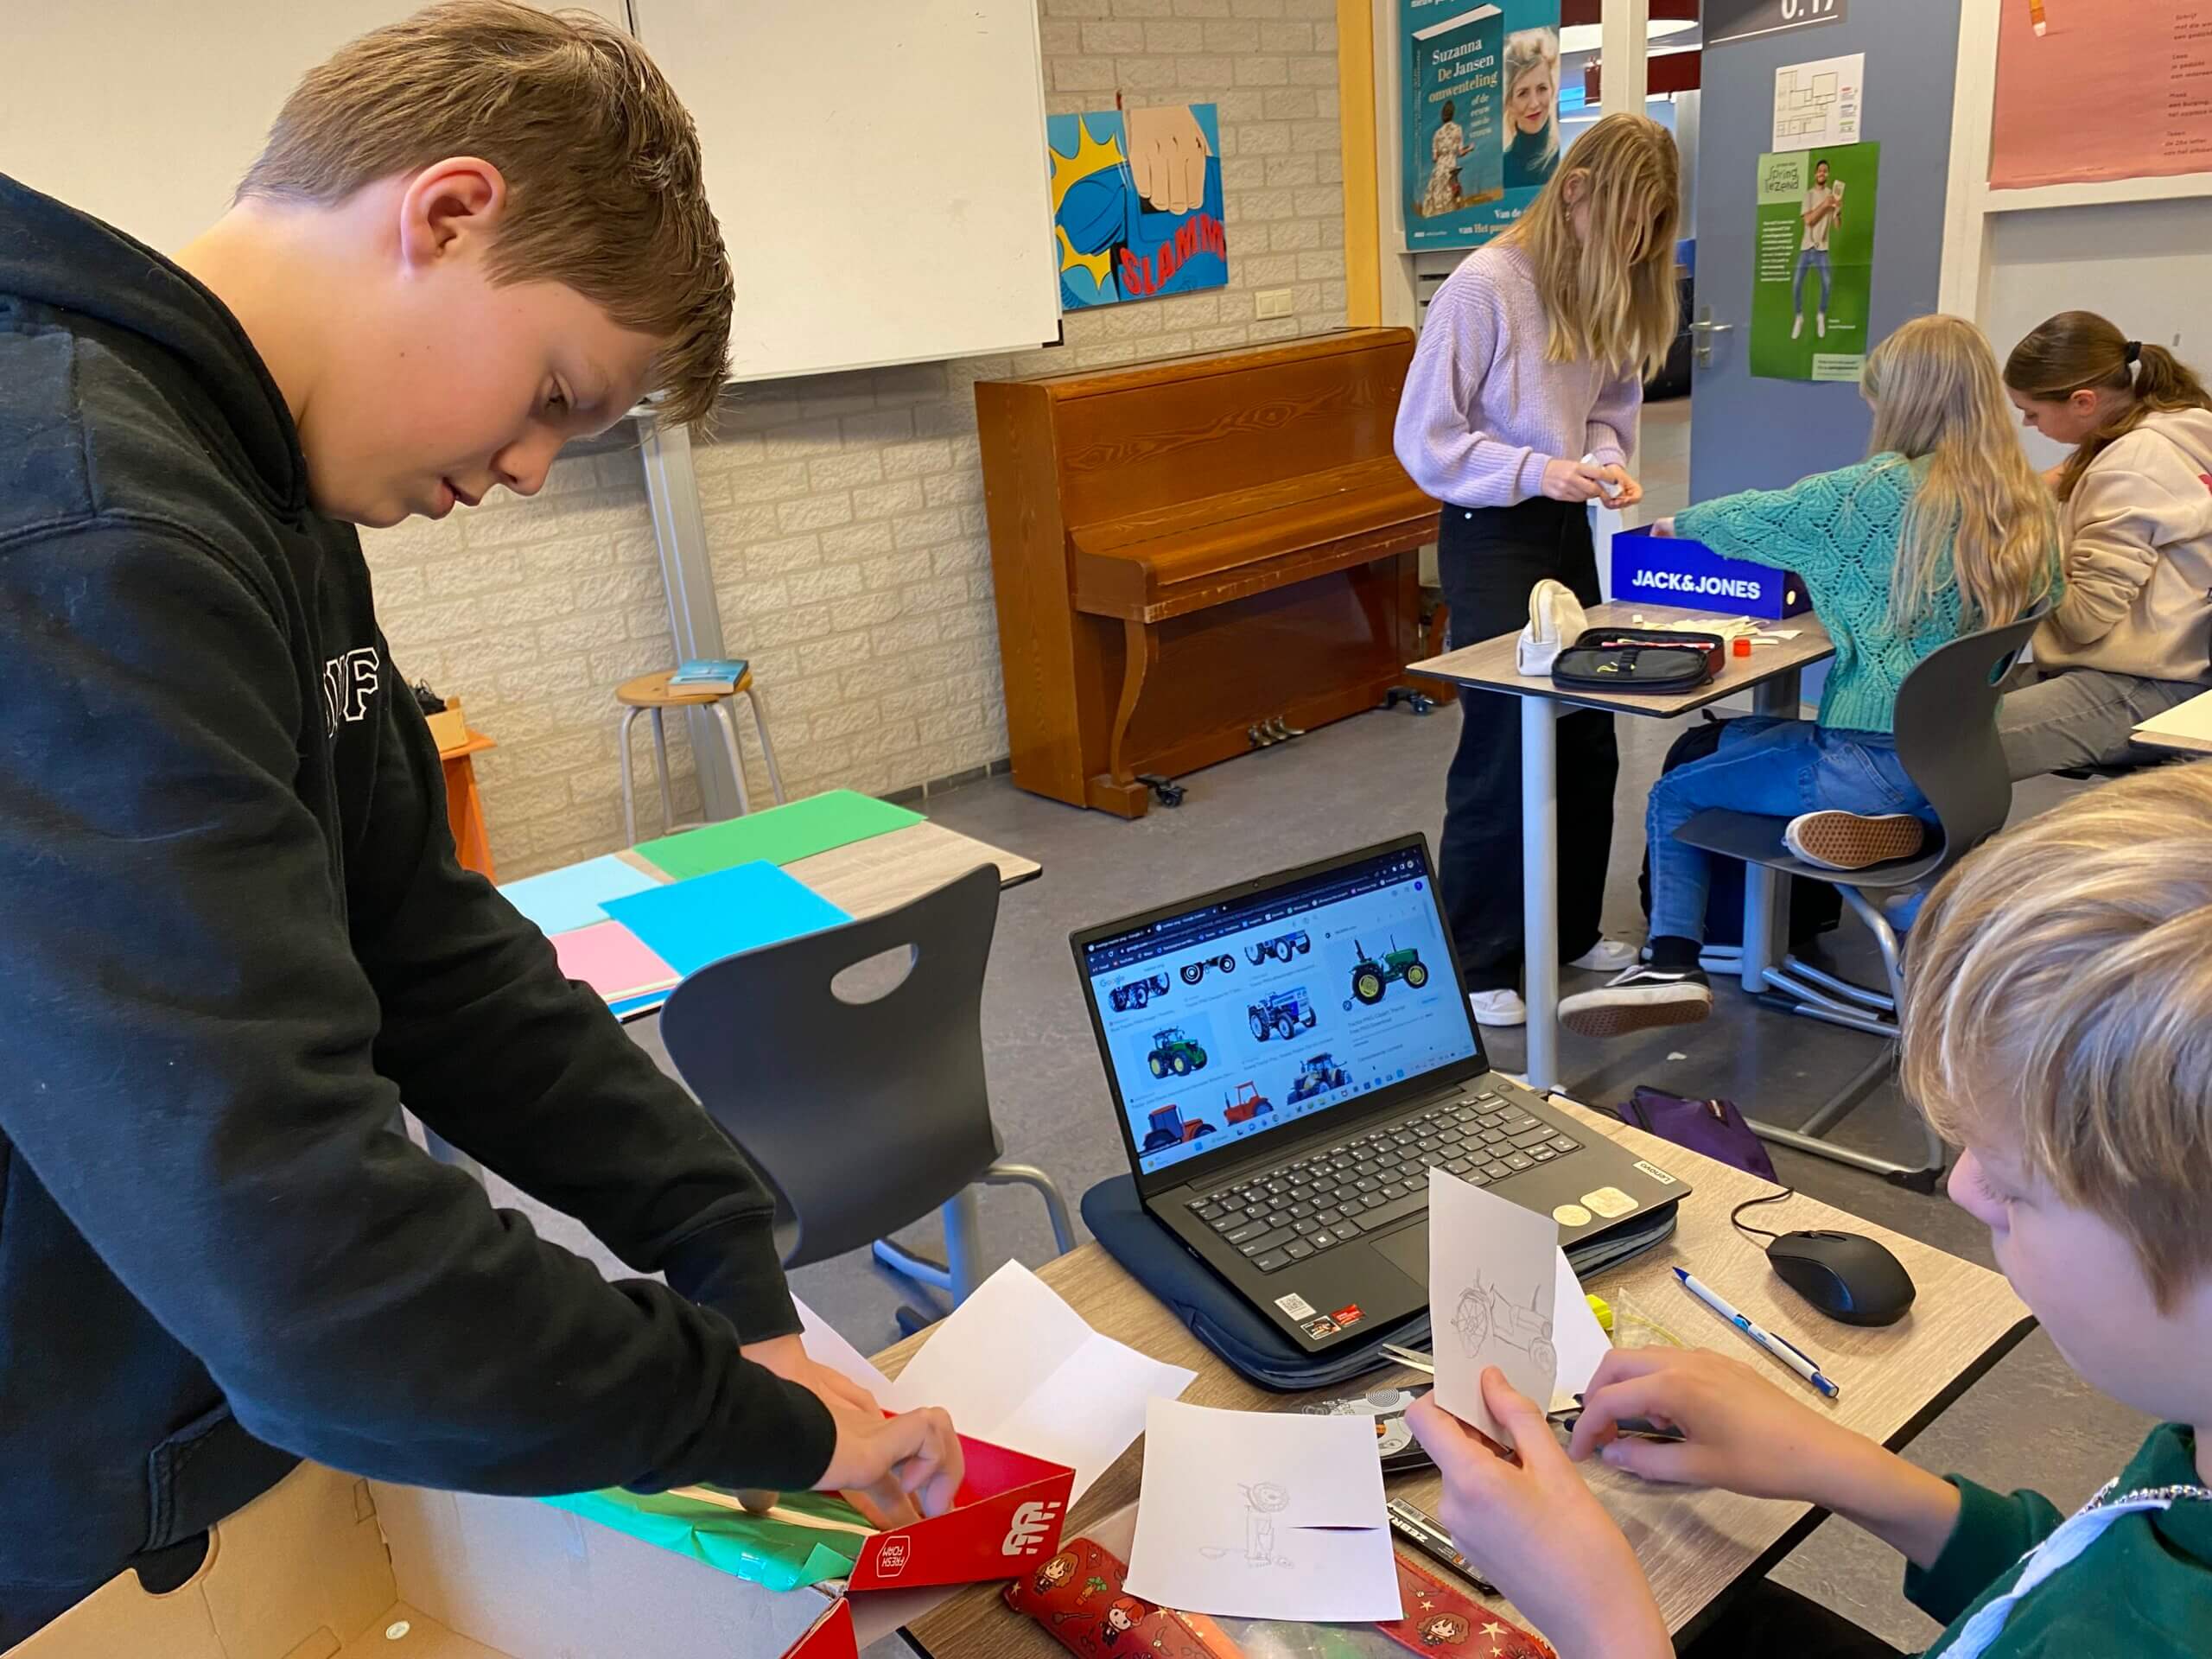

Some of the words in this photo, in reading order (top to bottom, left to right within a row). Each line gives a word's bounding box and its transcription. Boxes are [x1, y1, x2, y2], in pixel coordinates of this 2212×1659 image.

[1432, 39, 1483, 66] Suzanna
[1438, 68, 1452, 82] De
[1453, 54, 1494, 78] Jansen
[1428, 71, 1498, 103] omwenteling
[1631, 569, 1762, 601] JACK&JONES
[1640, 1163, 1671, 1183] Lenovo
[881, 1556, 905, 1567] FRESH
[882, 1545, 904, 1557] FOAM
